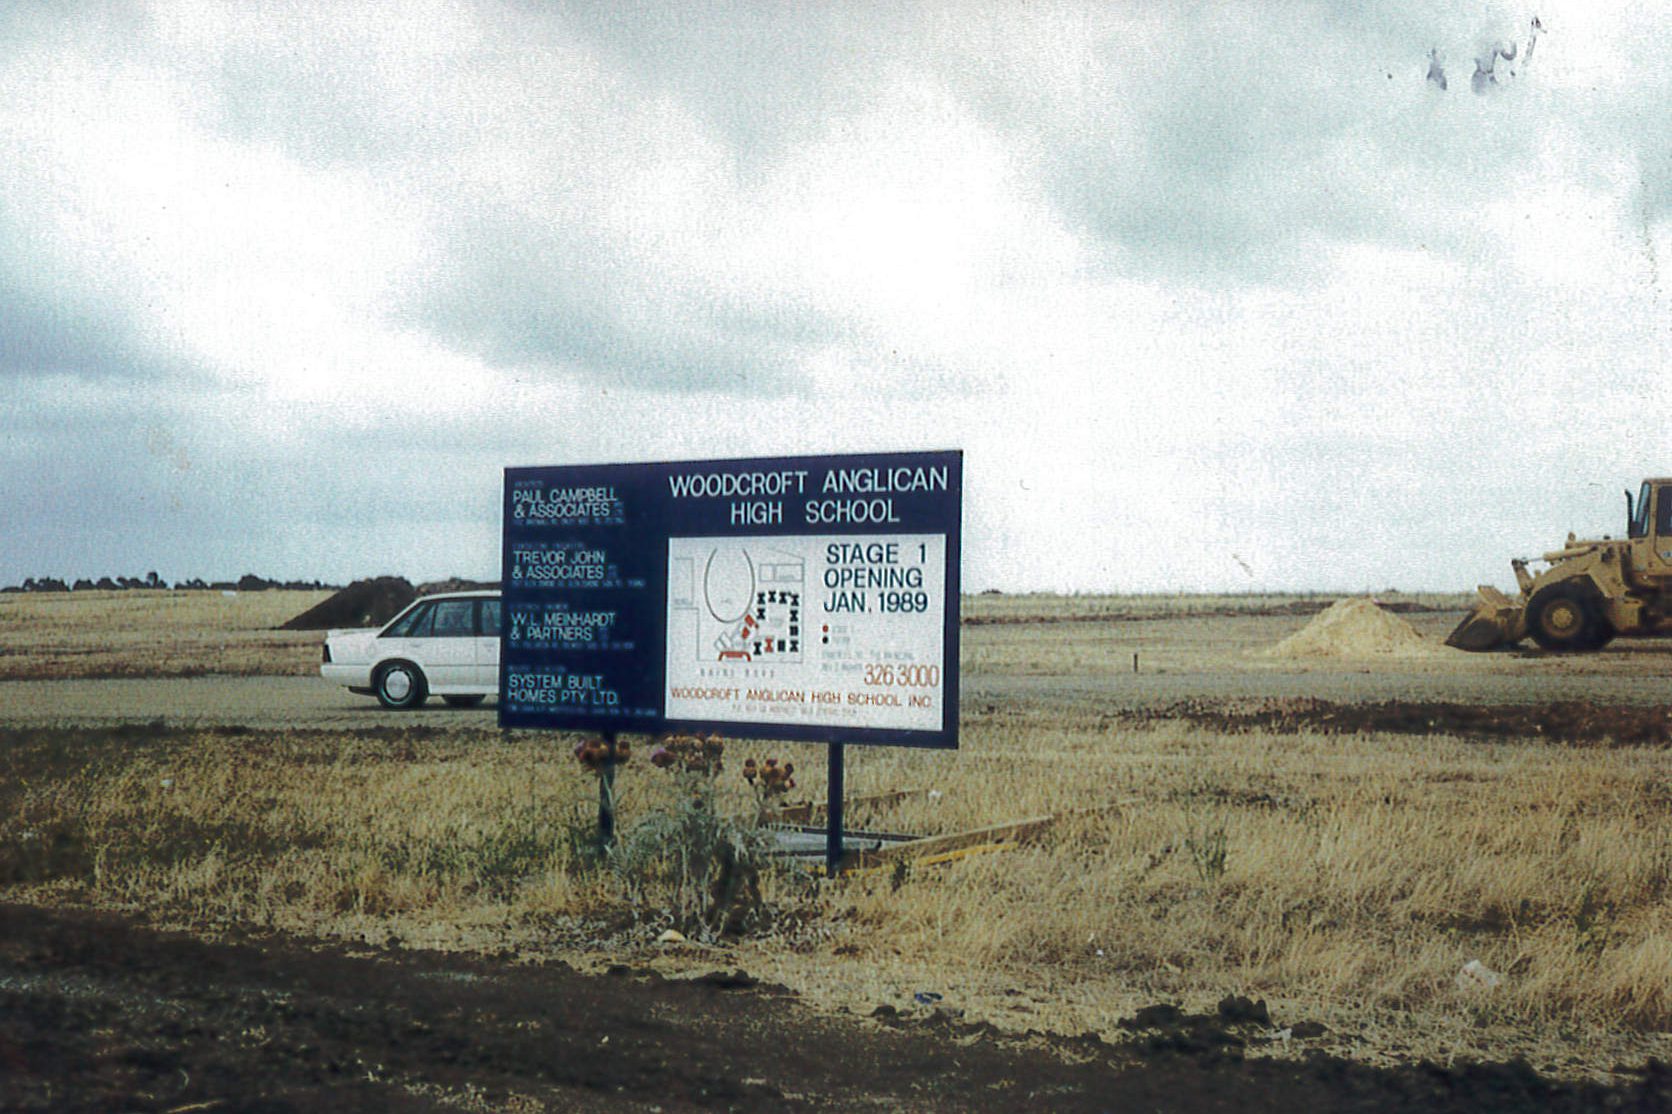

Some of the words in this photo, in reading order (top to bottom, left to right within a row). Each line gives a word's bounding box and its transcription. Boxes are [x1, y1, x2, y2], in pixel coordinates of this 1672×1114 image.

[669, 471, 808, 498] WOODCROFT
[823, 466, 948, 493] ANGLICAN
[513, 489, 544, 504] PAUL
[550, 487, 618, 503] CAMPBELL
[514, 504, 525, 518] &
[529, 502, 610, 518] ASSOCIATES
[731, 502, 782, 525] HIGH
[806, 499, 900, 523] SCHOOL
[513, 551, 566, 564] TREVOR
[570, 551, 606, 563] JOHN
[826, 543, 899, 564] STAGE
[919, 543, 926, 563] 1
[512, 565, 522, 579] &
[527, 565, 604, 579] ASSOCIATES
[824, 567, 923, 589] OPENING
[878, 591, 929, 613] 1989
[544, 612, 616, 626] MEINHARDT
[511, 626, 521, 640] &
[527, 626, 593, 641] PARTNERS
[508, 674, 562, 689] SYSTEM
[568, 675, 604, 690] BUILT
[863, 663, 895, 686] 326
[896, 664, 940, 688] 3000
[507, 688, 556, 704] HOMES
[671, 687, 740, 701] WOODCROFT
[746, 689, 806, 704] ANGLICAN
[811, 692, 842, 705] HIGH
[847, 693, 903, 707] SCHOOL
